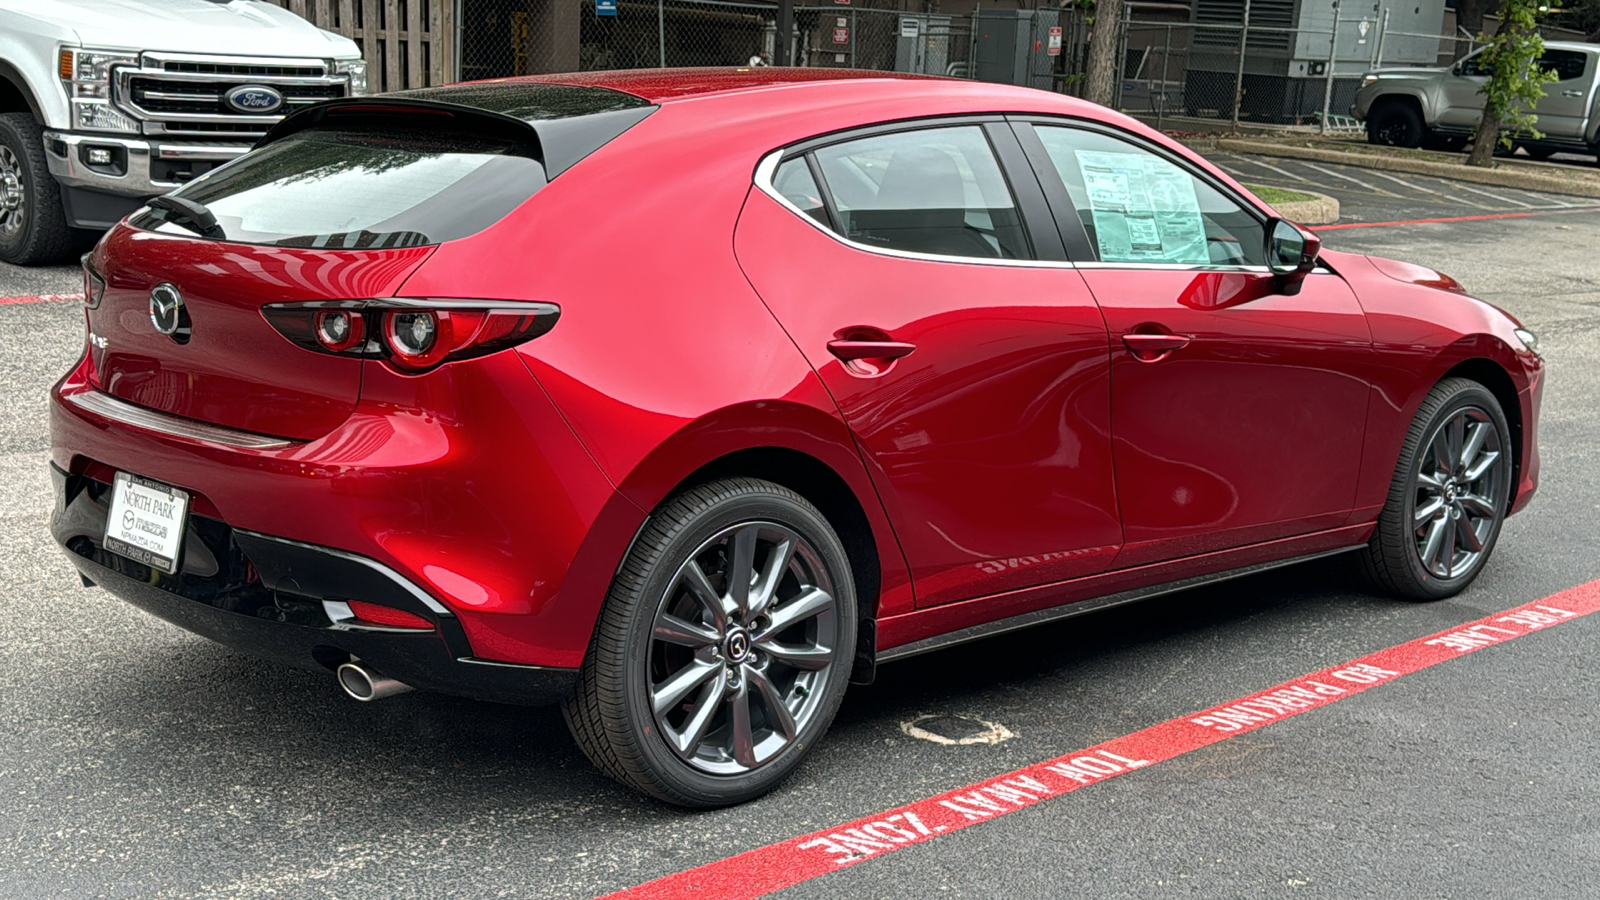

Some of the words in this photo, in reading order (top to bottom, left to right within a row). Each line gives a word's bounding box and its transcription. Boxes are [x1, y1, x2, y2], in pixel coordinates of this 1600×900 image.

[243, 93, 270, 106] Ford
[144, 480, 170, 493] ANTONIO
[123, 490, 151, 513] NORTH
[152, 499, 176, 520] PARK
[107, 539, 126, 555] NORTH
[126, 546, 144, 560] PARK
[121, 530, 164, 552] NPMAZDA.COM
[1496, 605, 1577, 629] FIRE
[1424, 624, 1518, 652] LANE
[1331, 662, 1398, 688] NO
[1191, 681, 1346, 732] PARKING
[1044, 749, 1149, 784] TOW
[939, 773, 1053, 820] AWAY
[797, 811, 947, 865] ZONE
